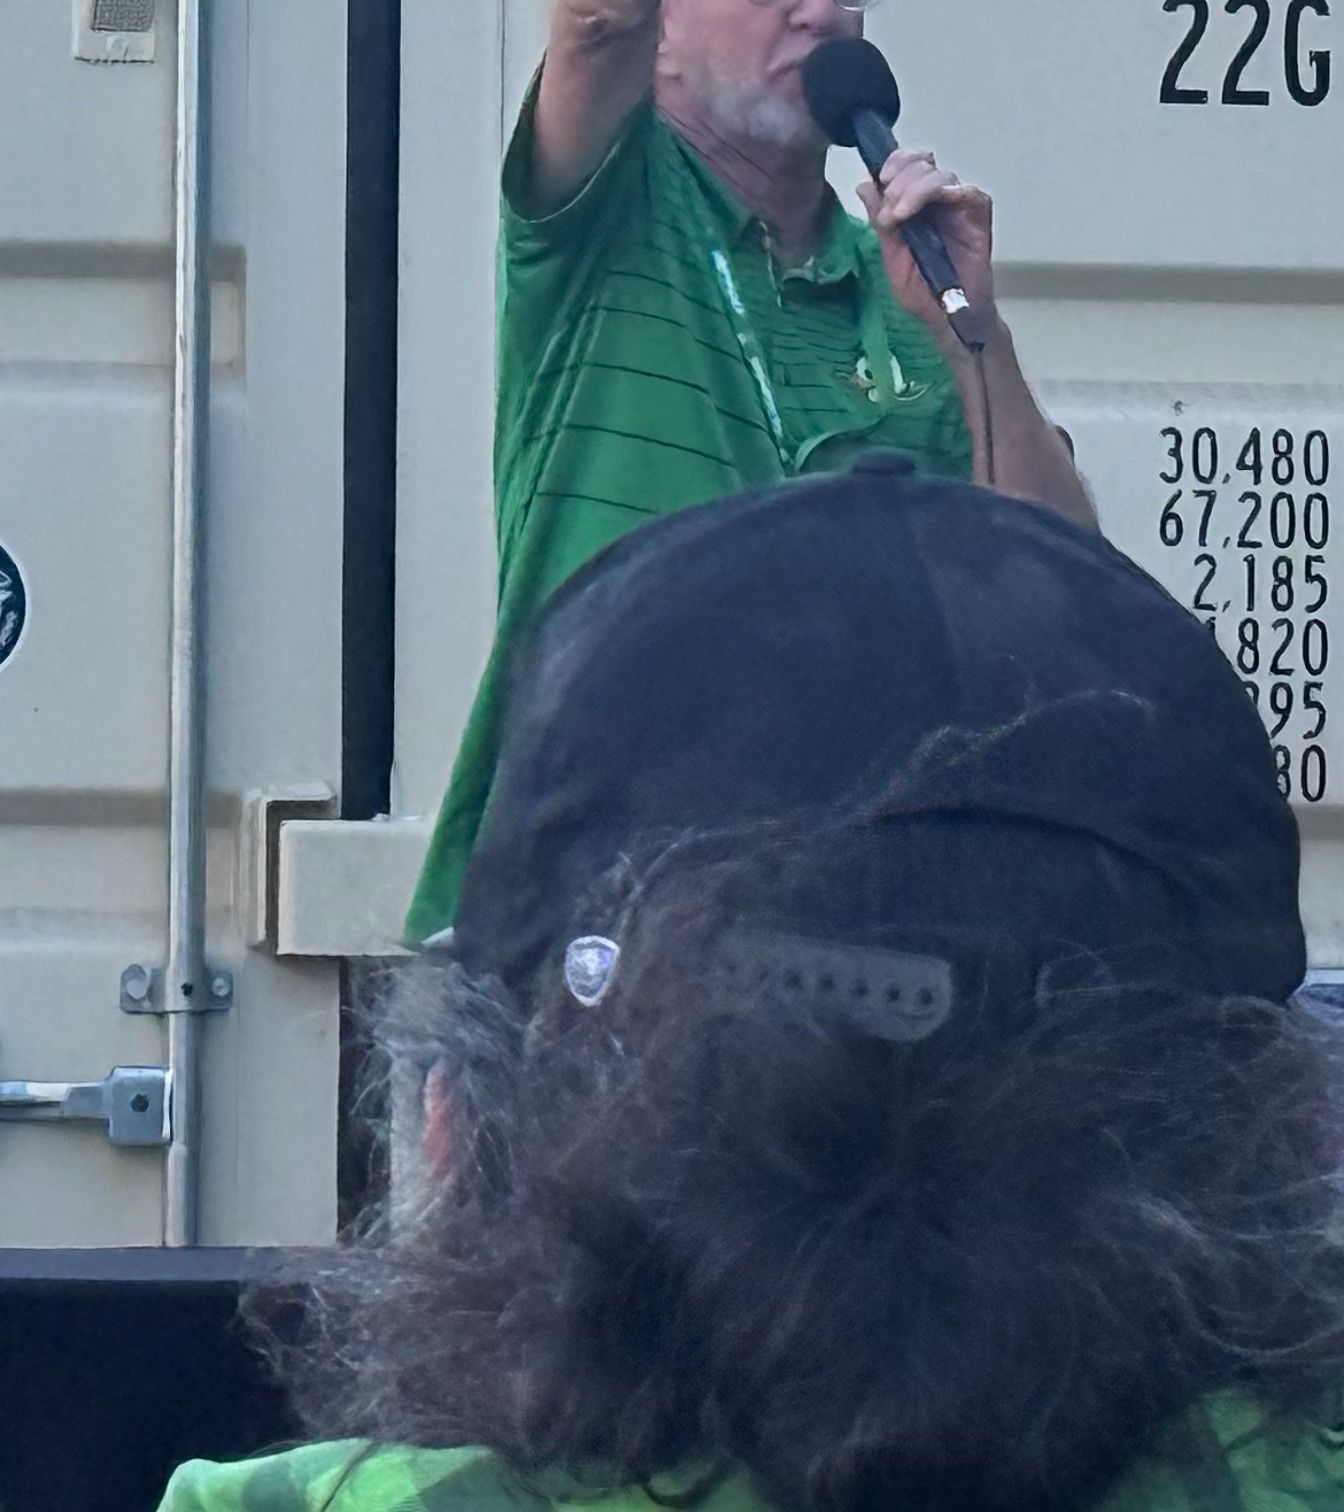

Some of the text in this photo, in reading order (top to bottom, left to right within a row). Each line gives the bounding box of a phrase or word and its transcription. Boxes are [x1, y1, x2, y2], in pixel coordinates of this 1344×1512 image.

[1159, 426, 1330, 486] 30,480
[1159, 489, 1330, 550] 67,200
[1192, 553, 1328, 614] 2,185
[1205, 616, 1328, 676] 820
